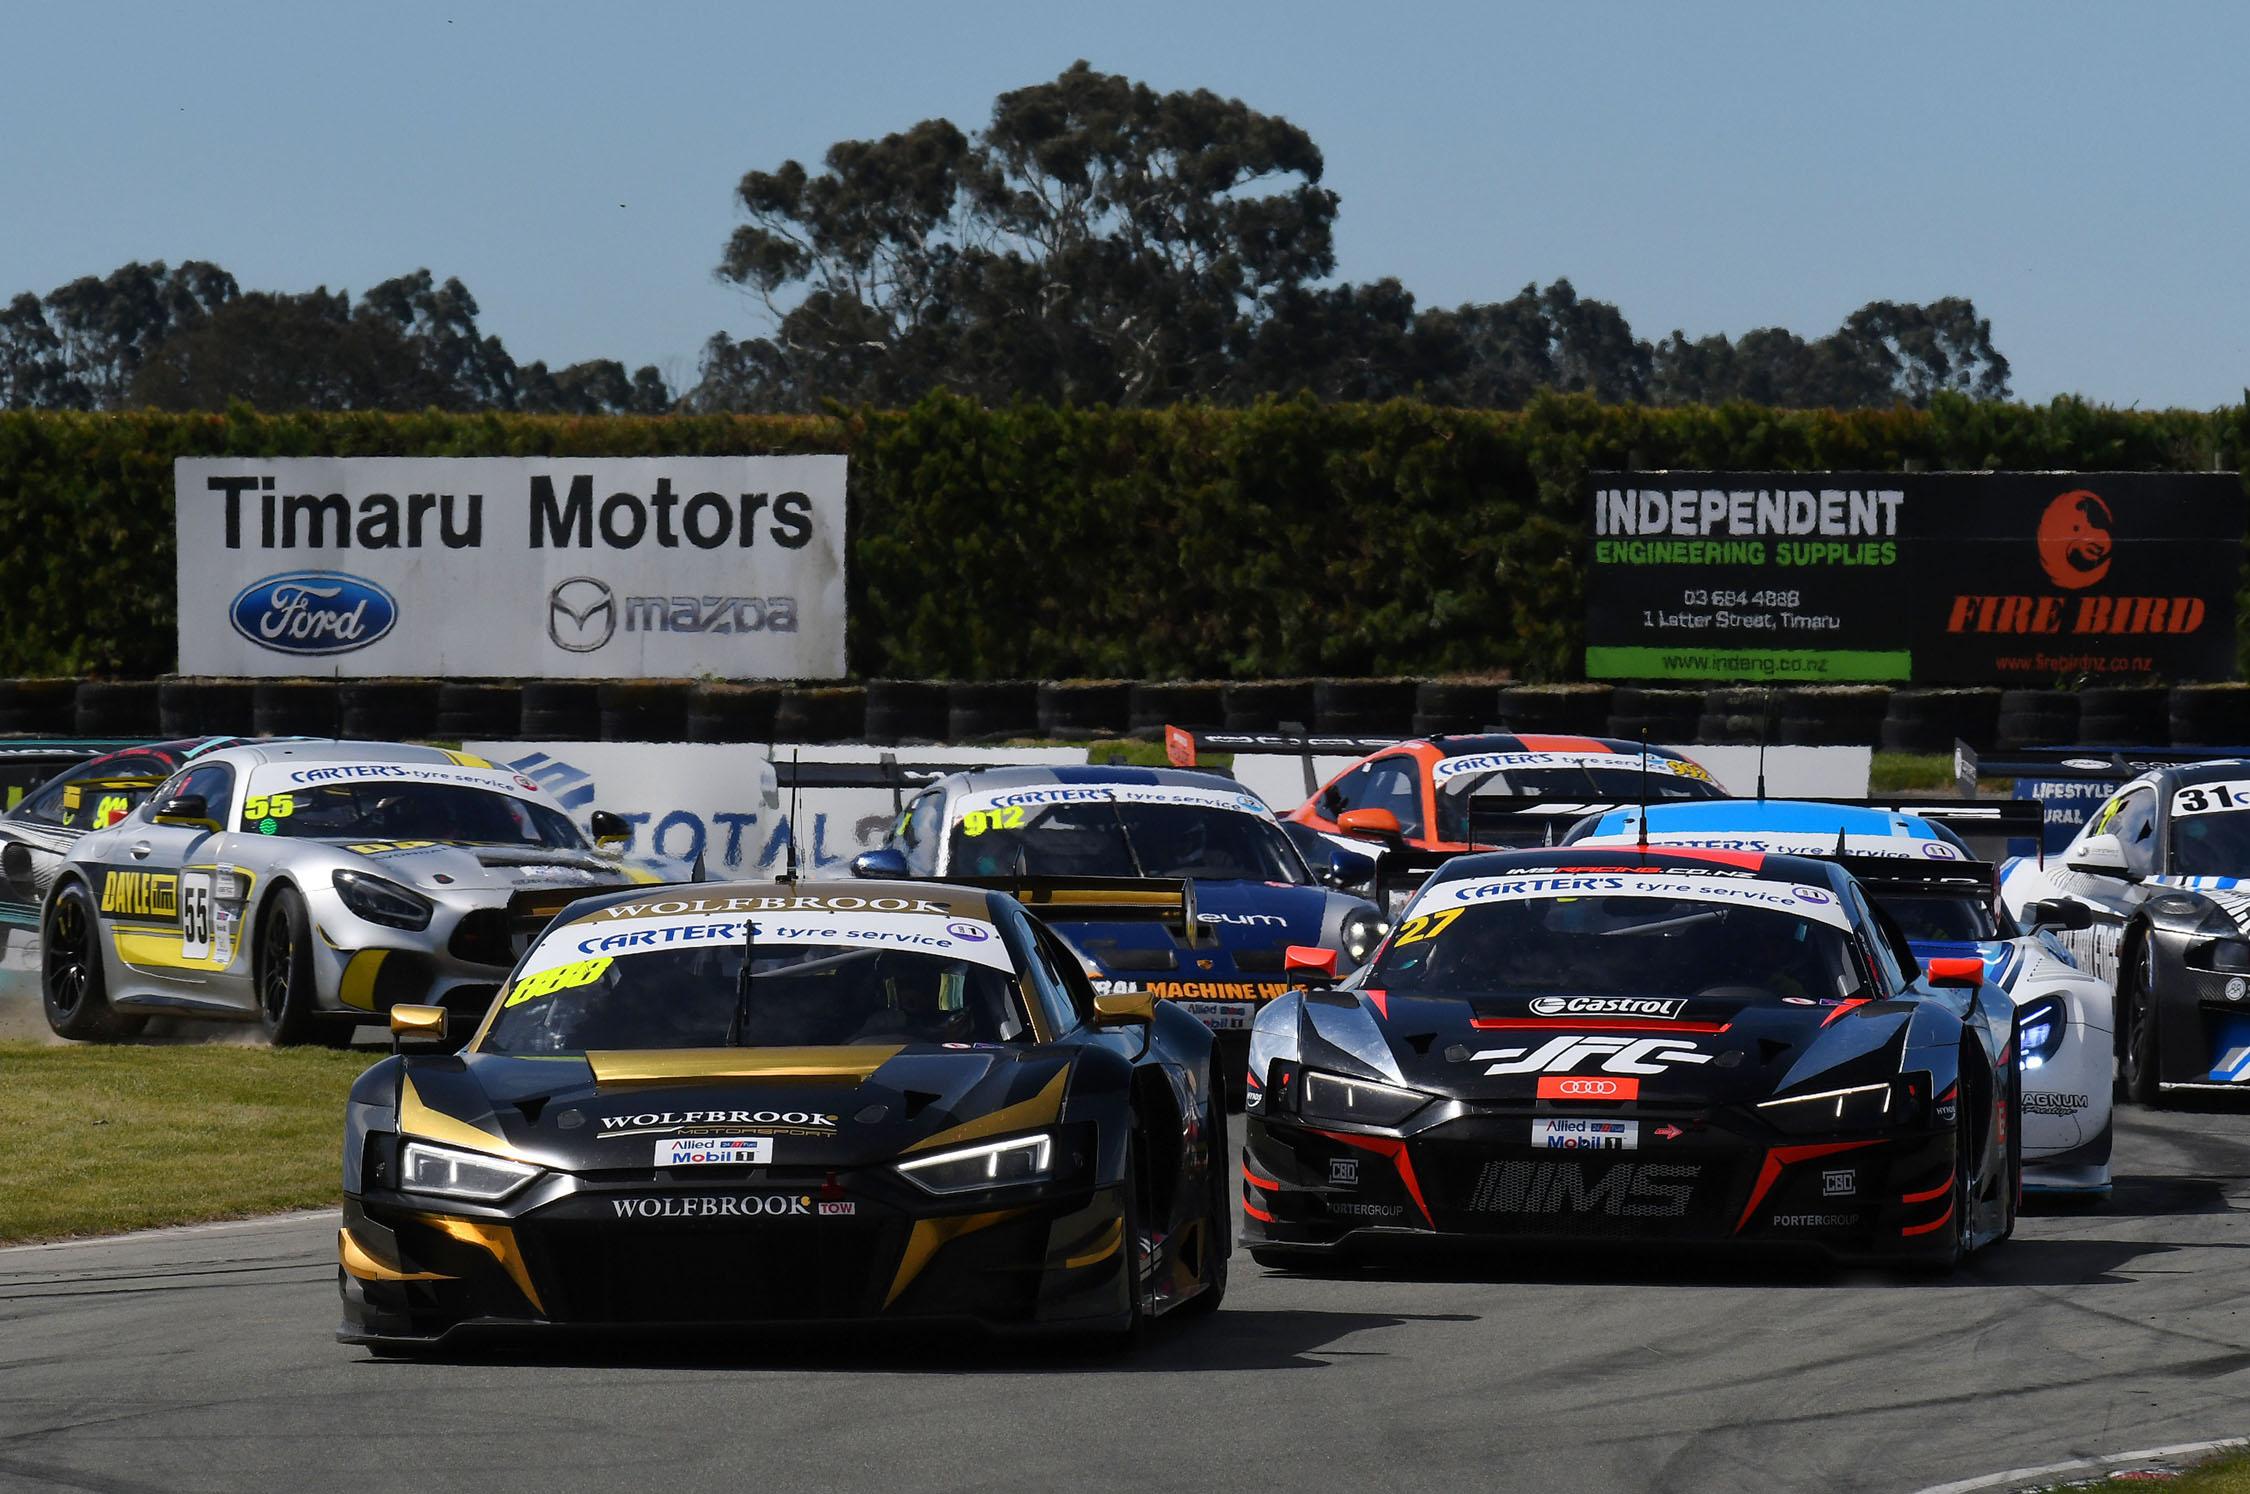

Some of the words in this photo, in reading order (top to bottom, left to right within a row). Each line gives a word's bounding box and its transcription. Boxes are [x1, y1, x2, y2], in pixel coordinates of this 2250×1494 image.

[207, 475, 482, 549] Timaru
[528, 475, 814, 550] Motors
[1596, 488, 1904, 535] INDEPENDENT
[1596, 540, 1766, 565] ENGINEERING
[1775, 541, 1897, 565] SUPPLIES
[259, 585, 365, 641] Ford
[1780, 611, 1840, 629] Timaru
[1947, 595, 2065, 634] FIRE
[2072, 597, 2205, 634] BIRD
[1439, 752, 1553, 775] CARTER'S
[291, 765, 405, 784] CARTER'S
[412, 769, 451, 783] tyre
[454, 773, 515, 791] service
[990, 787, 1117, 807] CARTER'S
[1172, 795, 1241, 811] service
[2032, 783, 2114, 798] LIFESTYLE
[2179, 785, 2234, 811] 31
[244, 794, 294, 820] 55
[963, 805, 1025, 837] 912
[100, 871, 150, 914] DAYLE
[1455, 877, 1624, 900] CARTER'S
[1635, 880, 1692, 894] tyre
[1699, 886, 1797, 907] service
[185, 887, 208, 943] 55
[604, 896, 951, 918] WOLFBROOK
[577, 922, 763, 954] CARTER'S
[777, 926, 837, 938] tyre
[846, 929, 953, 948] service
[1394, 907, 1466, 948] 27
[504, 956, 615, 1009] 888
[1146, 982, 1257, 1000] MACHINE
[1567, 997, 1671, 1015] Castrol
[1482, 1036, 1699, 1076] JFC
[2022, 1093, 2089, 1108] AGNUM
[601, 1110, 836, 1129] WOLFBROOK
[1546, 1120, 1586, 1132] Allied
[672, 1140, 715, 1150] Allied
[677, 1128, 838, 1138] MOTORSPORT
[1547, 1136, 1601, 1149] Mobil
[672, 1151, 731, 1163] Mobil
[611, 1195, 811, 1218] WOLFBROOK
[821, 1203, 854, 1214] TOW
[1773, 1214, 1860, 1227] PORTERGROUP
